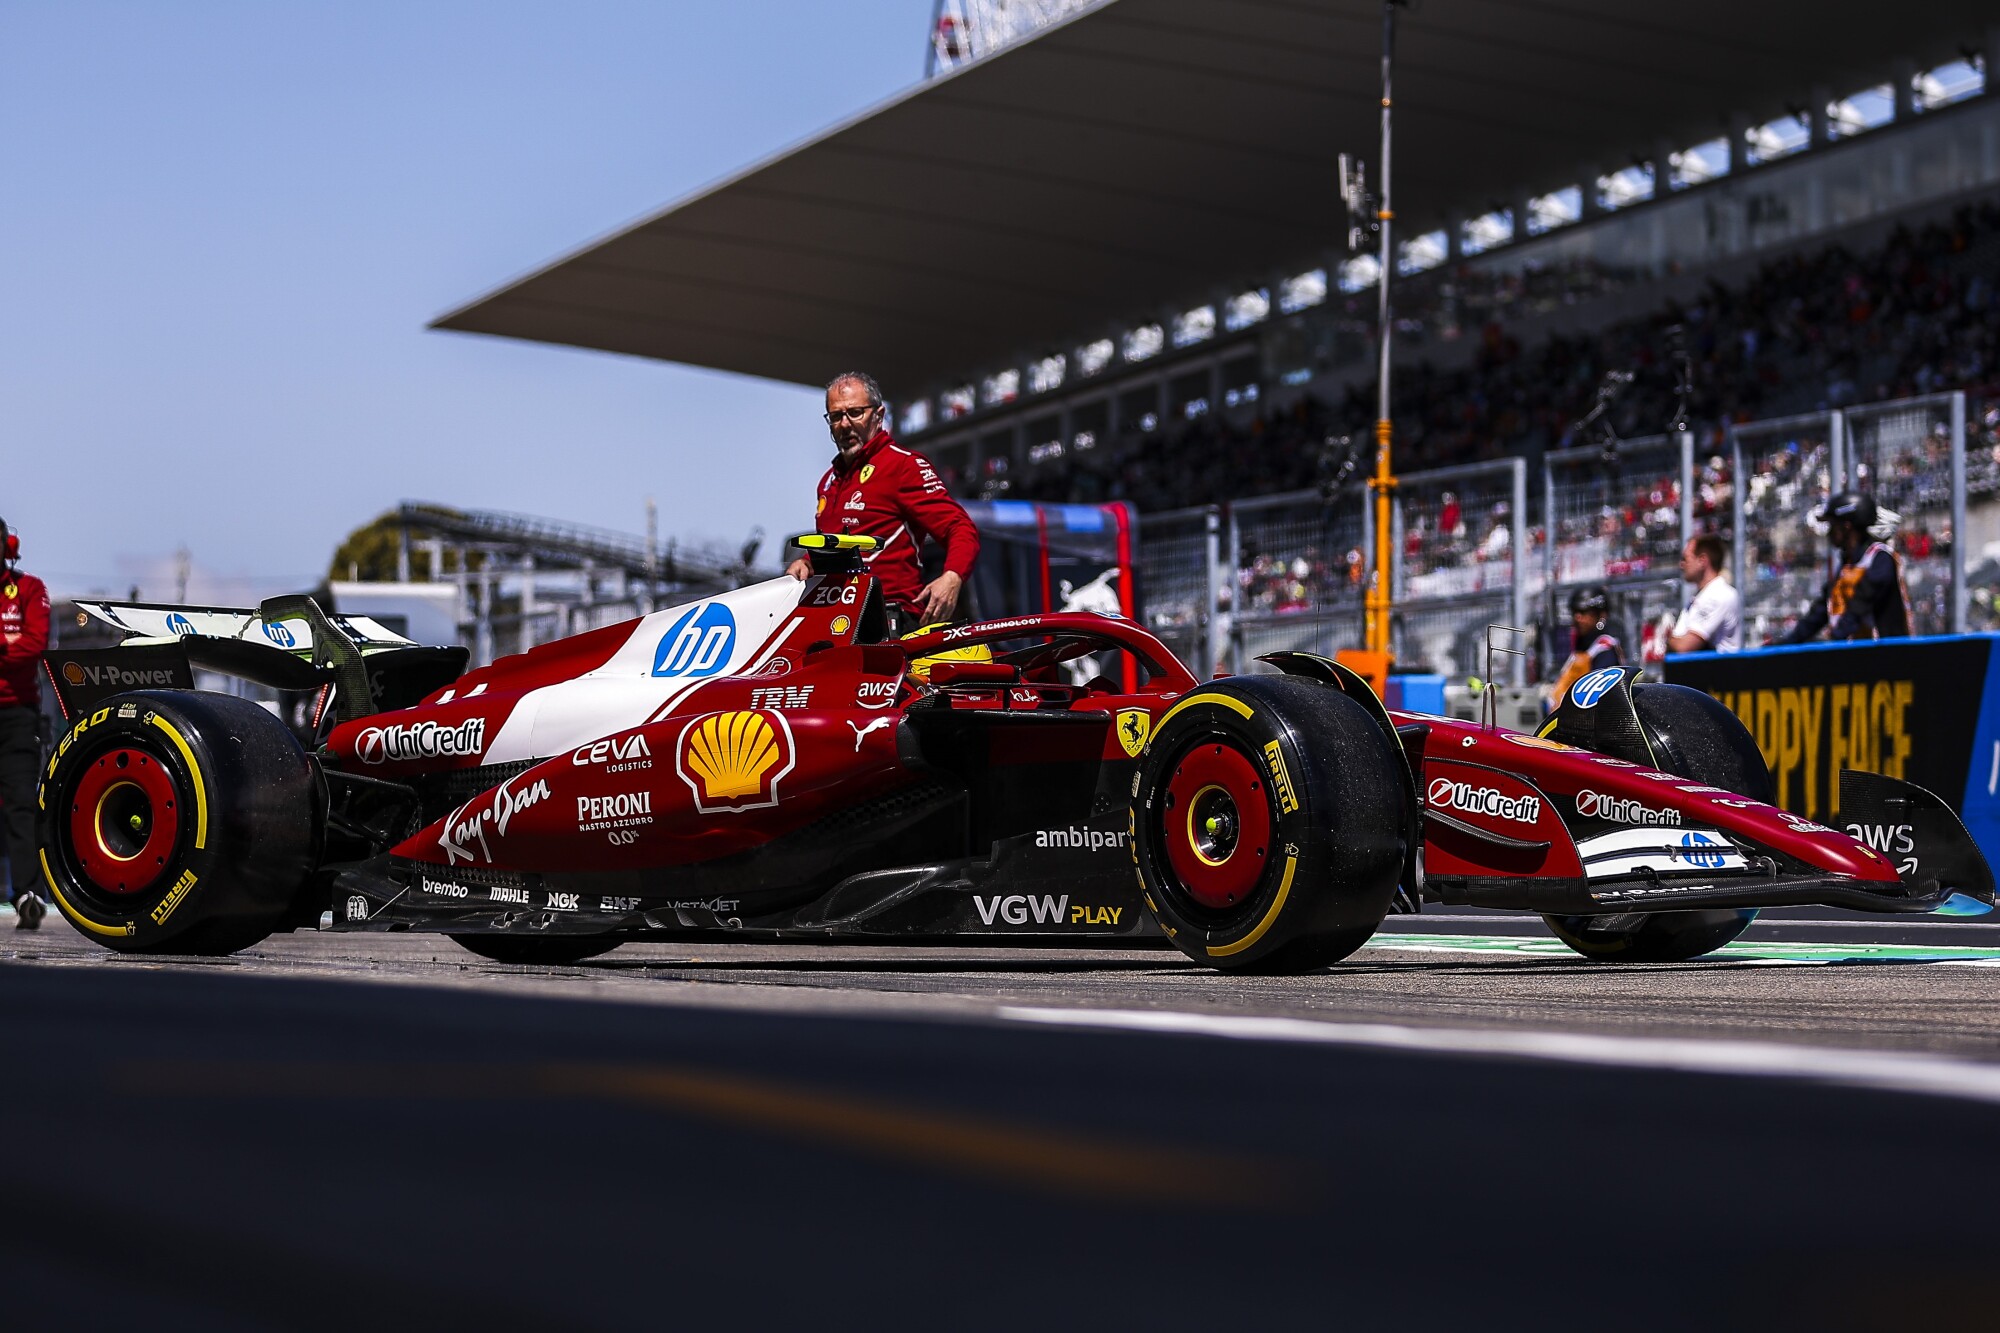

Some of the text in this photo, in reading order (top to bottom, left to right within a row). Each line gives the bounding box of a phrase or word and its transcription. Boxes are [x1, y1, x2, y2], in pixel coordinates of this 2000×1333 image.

[813, 586, 857, 604] ZCG
[267, 623, 292, 647] hp
[655, 603, 735, 677] hp
[943, 618, 1042, 641] DXC TECHNOLOGY
[85, 666, 174, 685] V-Power
[1574, 669, 1620, 707] hp
[751, 685, 814, 709] IBM
[858, 682, 896, 697] aws
[47, 707, 110, 779] ZERO
[383, 718, 485, 760] UniCredit
[1709, 685, 1825, 820] PPY
[607, 762, 653, 773] LOGISTICS
[1264, 740, 1298, 814] PIRELLI
[577, 791, 652, 821] PERONI
[1451, 783, 1540, 824] UniCredit
[1598, 794, 1682, 826] UniCredit
[579, 816, 654, 832] NASTRO AZZURRO
[1035, 826, 1127, 851] ambipar
[1684, 832, 1722, 868] hp
[1846, 823, 1914, 853] aws
[151, 869, 198, 926] PIRELLI
[422, 876, 469, 898] brembo
[489, 886, 530, 904] MAHLE
[547, 892, 580, 911] NGK
[600, 896, 642, 910] SKF
[973, 894, 1123, 925] VGW PLAY
